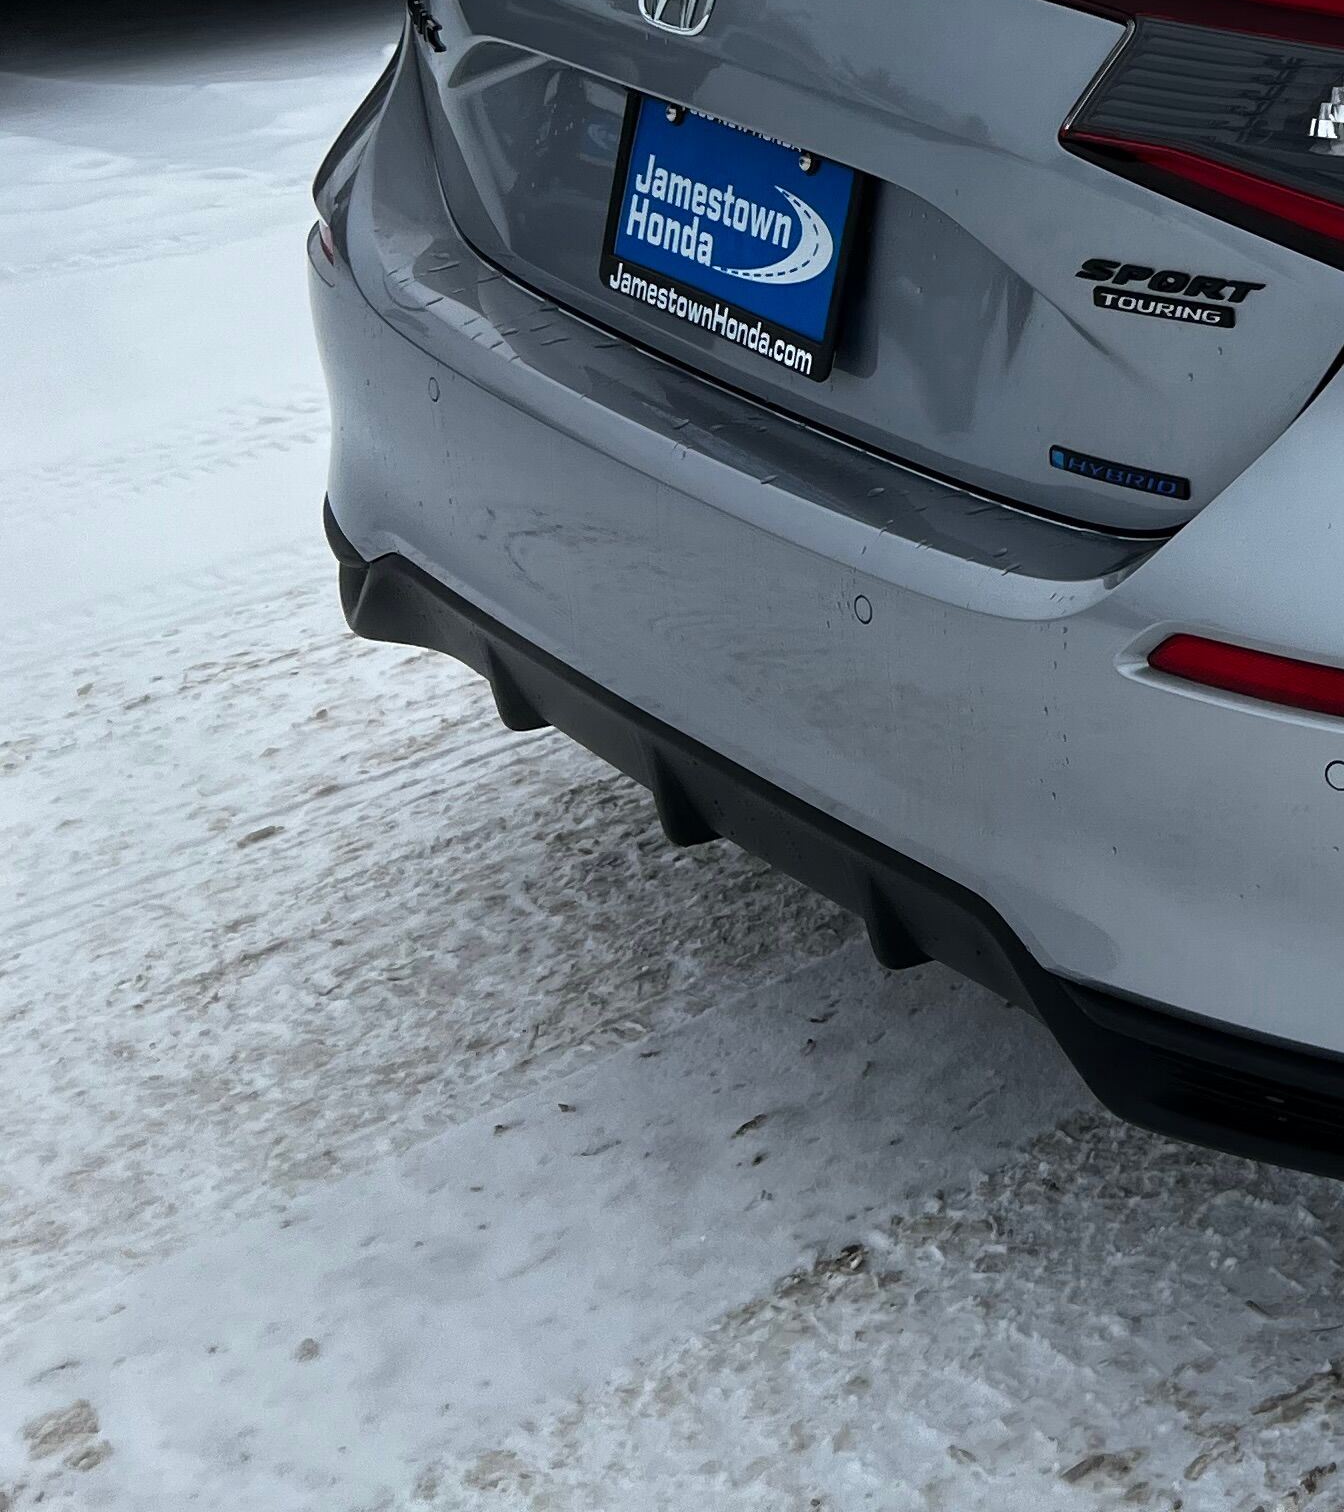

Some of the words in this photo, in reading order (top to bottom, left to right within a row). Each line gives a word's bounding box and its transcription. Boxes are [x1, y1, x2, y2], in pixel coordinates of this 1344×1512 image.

[626, 194, 714, 267] Honda
[635, 154, 793, 249] Jamestown
[1074, 258, 1267, 303] SPORT
[1099, 292, 1222, 324] TOURING
[609, 263, 813, 375] JamestownHonda.com
[1067, 455, 1177, 495] HYBRID
